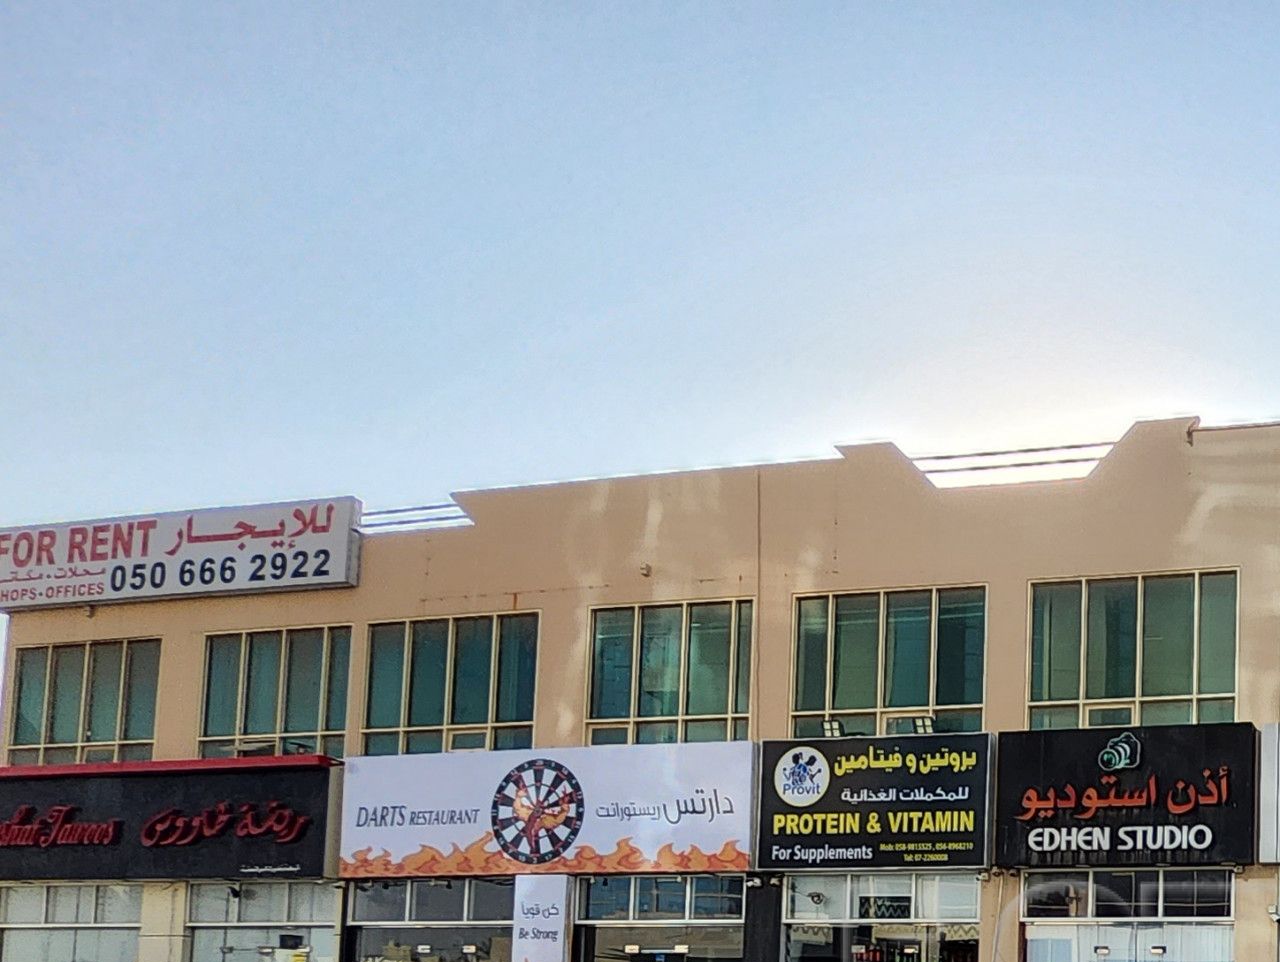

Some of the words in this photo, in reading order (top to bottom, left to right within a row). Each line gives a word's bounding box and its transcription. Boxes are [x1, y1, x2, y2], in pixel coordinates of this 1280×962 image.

[67, 519, 157, 564] RENT
[111, 562, 167, 592] 050
[179, 556, 237, 587] 666
[249, 548, 331, 582] 2922
[45, 582, 105, 599] OFFICES
[833, 745, 902, 776] فيتامين
[906, 752, 918, 774] و
[919, 747, 977, 774] بروتين
[782, 783, 821, 796] Provit
[840, 787, 897, 804] الغذائية
[900, 786, 970, 801] للمكملات
[1013, 773, 1157, 821] استوديو
[1167, 766, 1229, 814] أذن
[356, 805, 407, 828] DARTS
[409, 808, 481, 826] RESTAURANT
[595, 802, 661, 821] ريستورانت
[662, 788, 735, 824] دارتس
[773, 812, 860, 835] PROTEIN
[866, 812, 882, 834] &
[888, 810, 975, 833] VITAMIN
[1027, 826, 1111, 851] EDHEN
[1117, 824, 1213, 850] STUDIO
[771, 845, 794, 861] For
[795, 844, 874, 864] Supplements
[518, 927, 530, 939] Be
[530, 927, 559, 942] Strong
